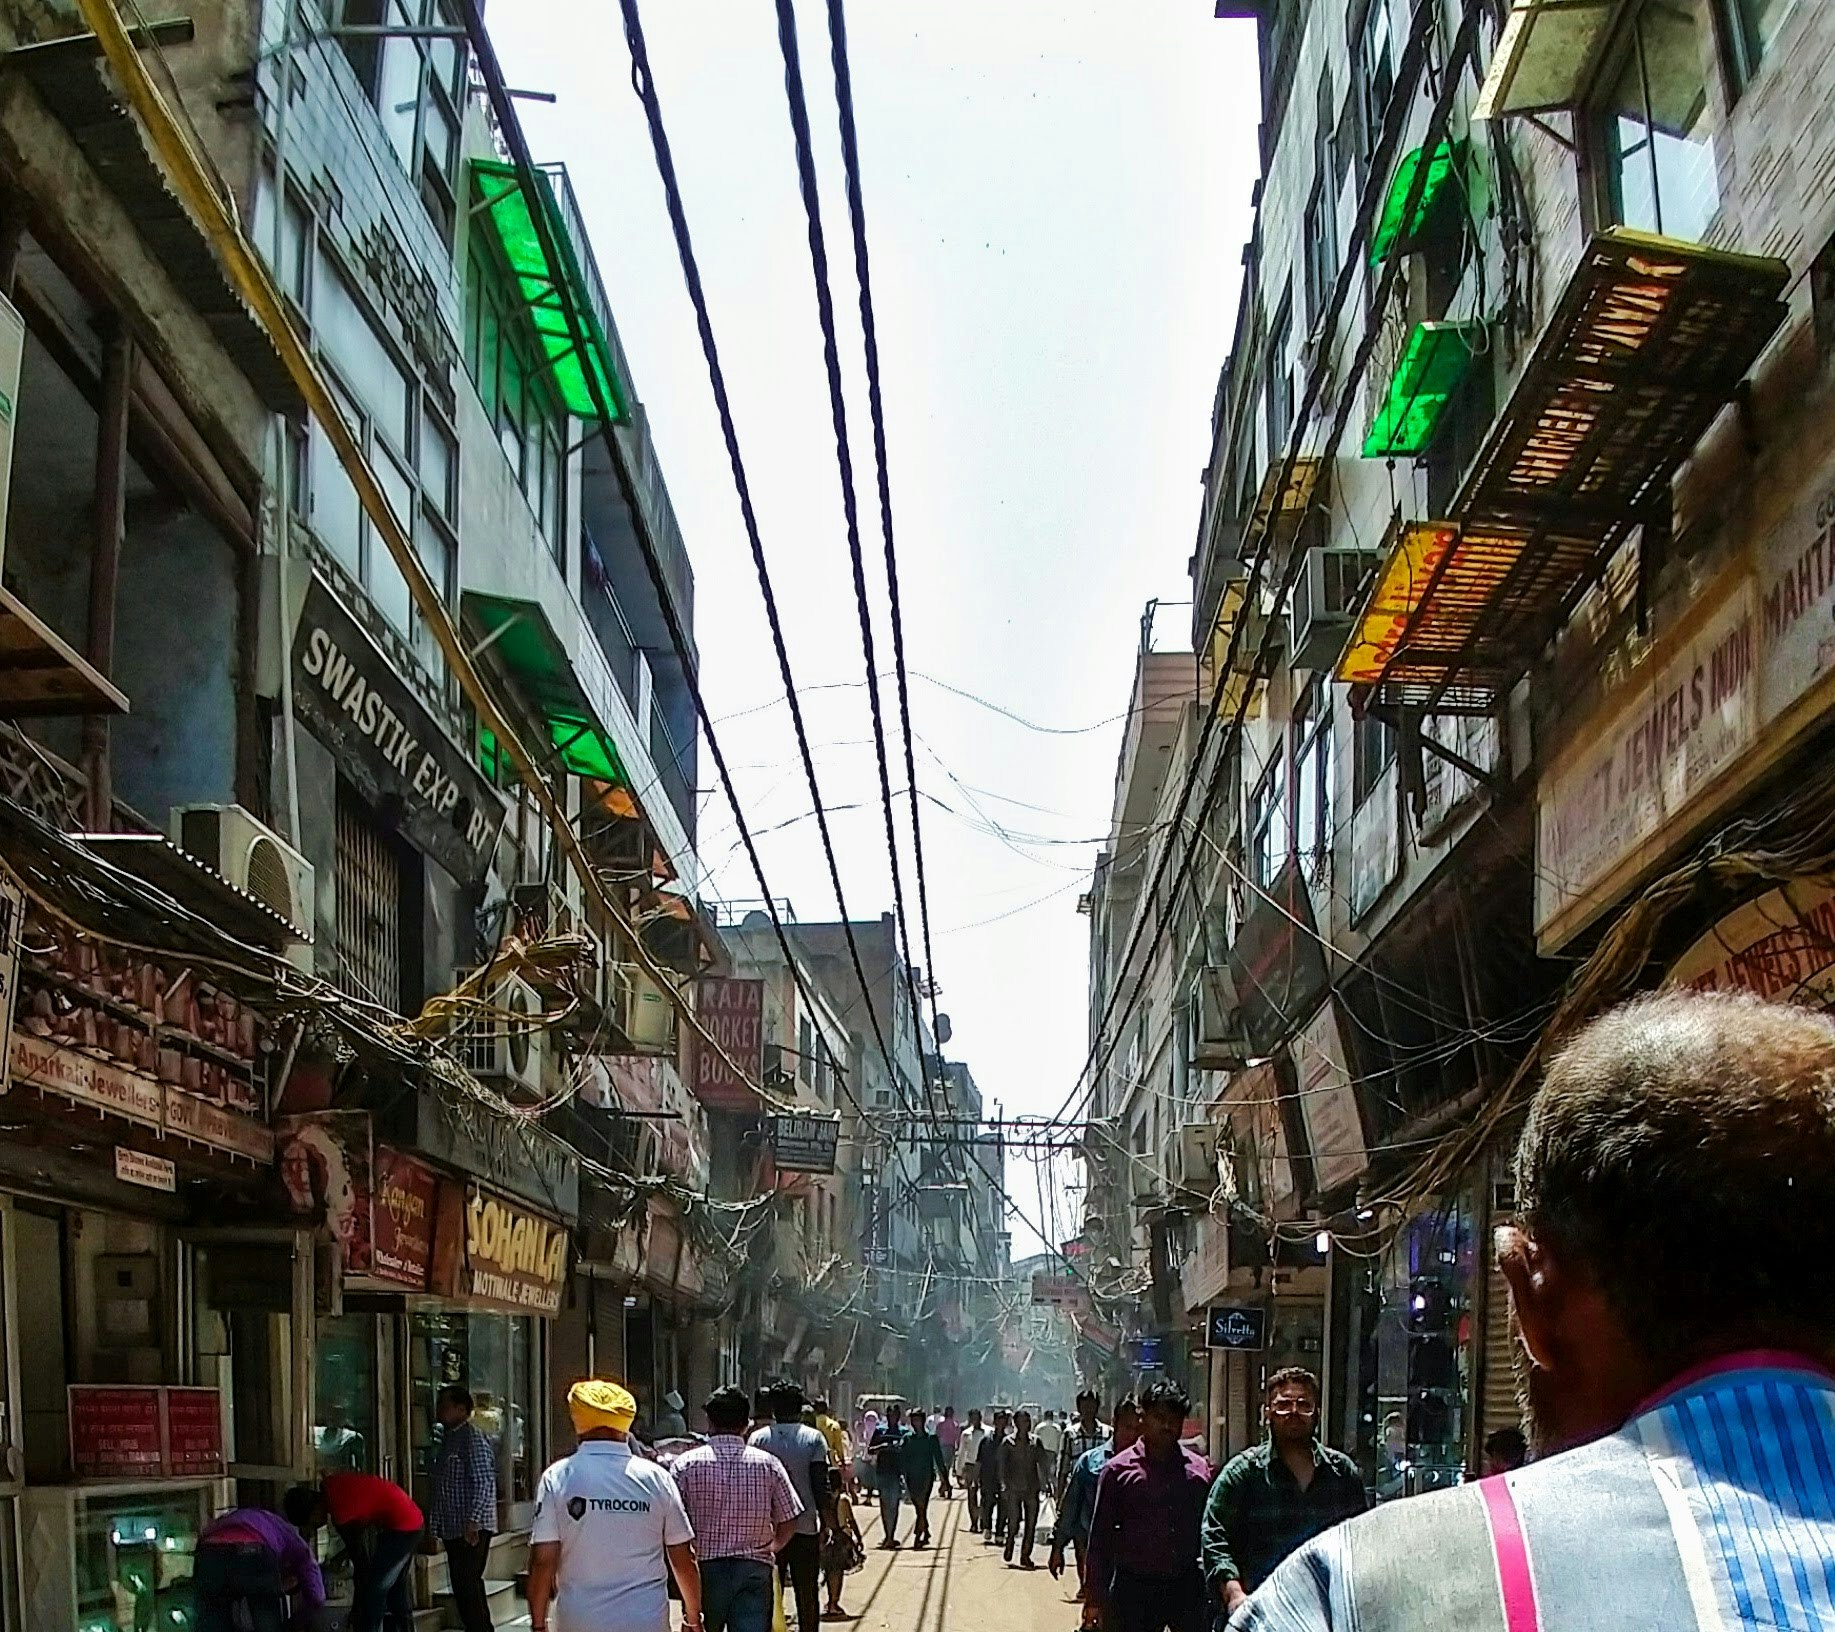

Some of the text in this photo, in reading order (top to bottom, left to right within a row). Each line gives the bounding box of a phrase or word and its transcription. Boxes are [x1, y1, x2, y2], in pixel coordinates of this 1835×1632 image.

[302, 627, 418, 777] SWASTIK
[412, 752, 494, 854] EXPRT
[1619, 664, 1704, 797] JEWELS
[702, 982, 760, 1009] RAJA
